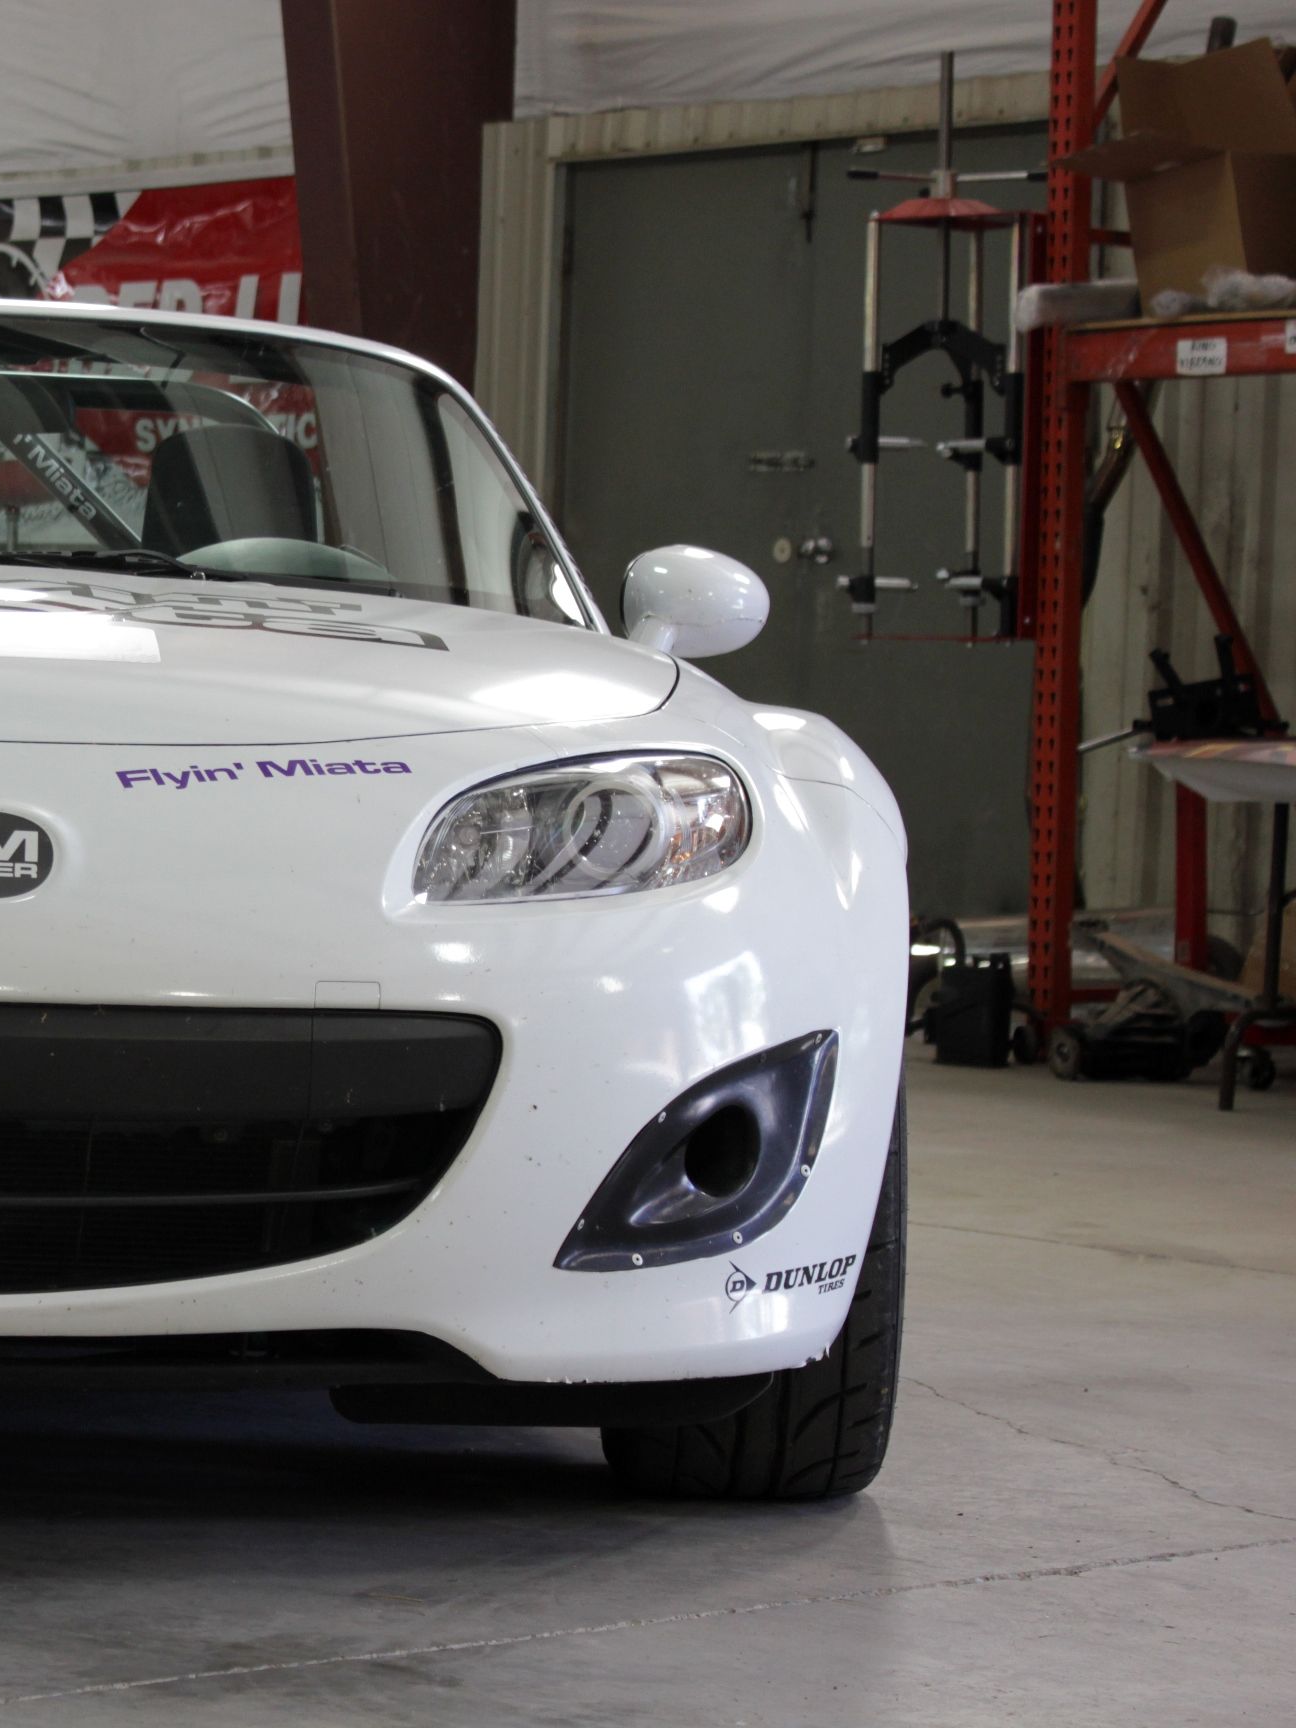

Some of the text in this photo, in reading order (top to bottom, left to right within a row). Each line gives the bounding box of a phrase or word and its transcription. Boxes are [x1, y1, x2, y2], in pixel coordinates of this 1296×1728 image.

[27, 444, 97, 520] Miata
[115, 758, 413, 790] Flyin' Miata
[762, 1253, 857, 1294] DUNLOP
[817, 1278, 846, 1295] TIRES
